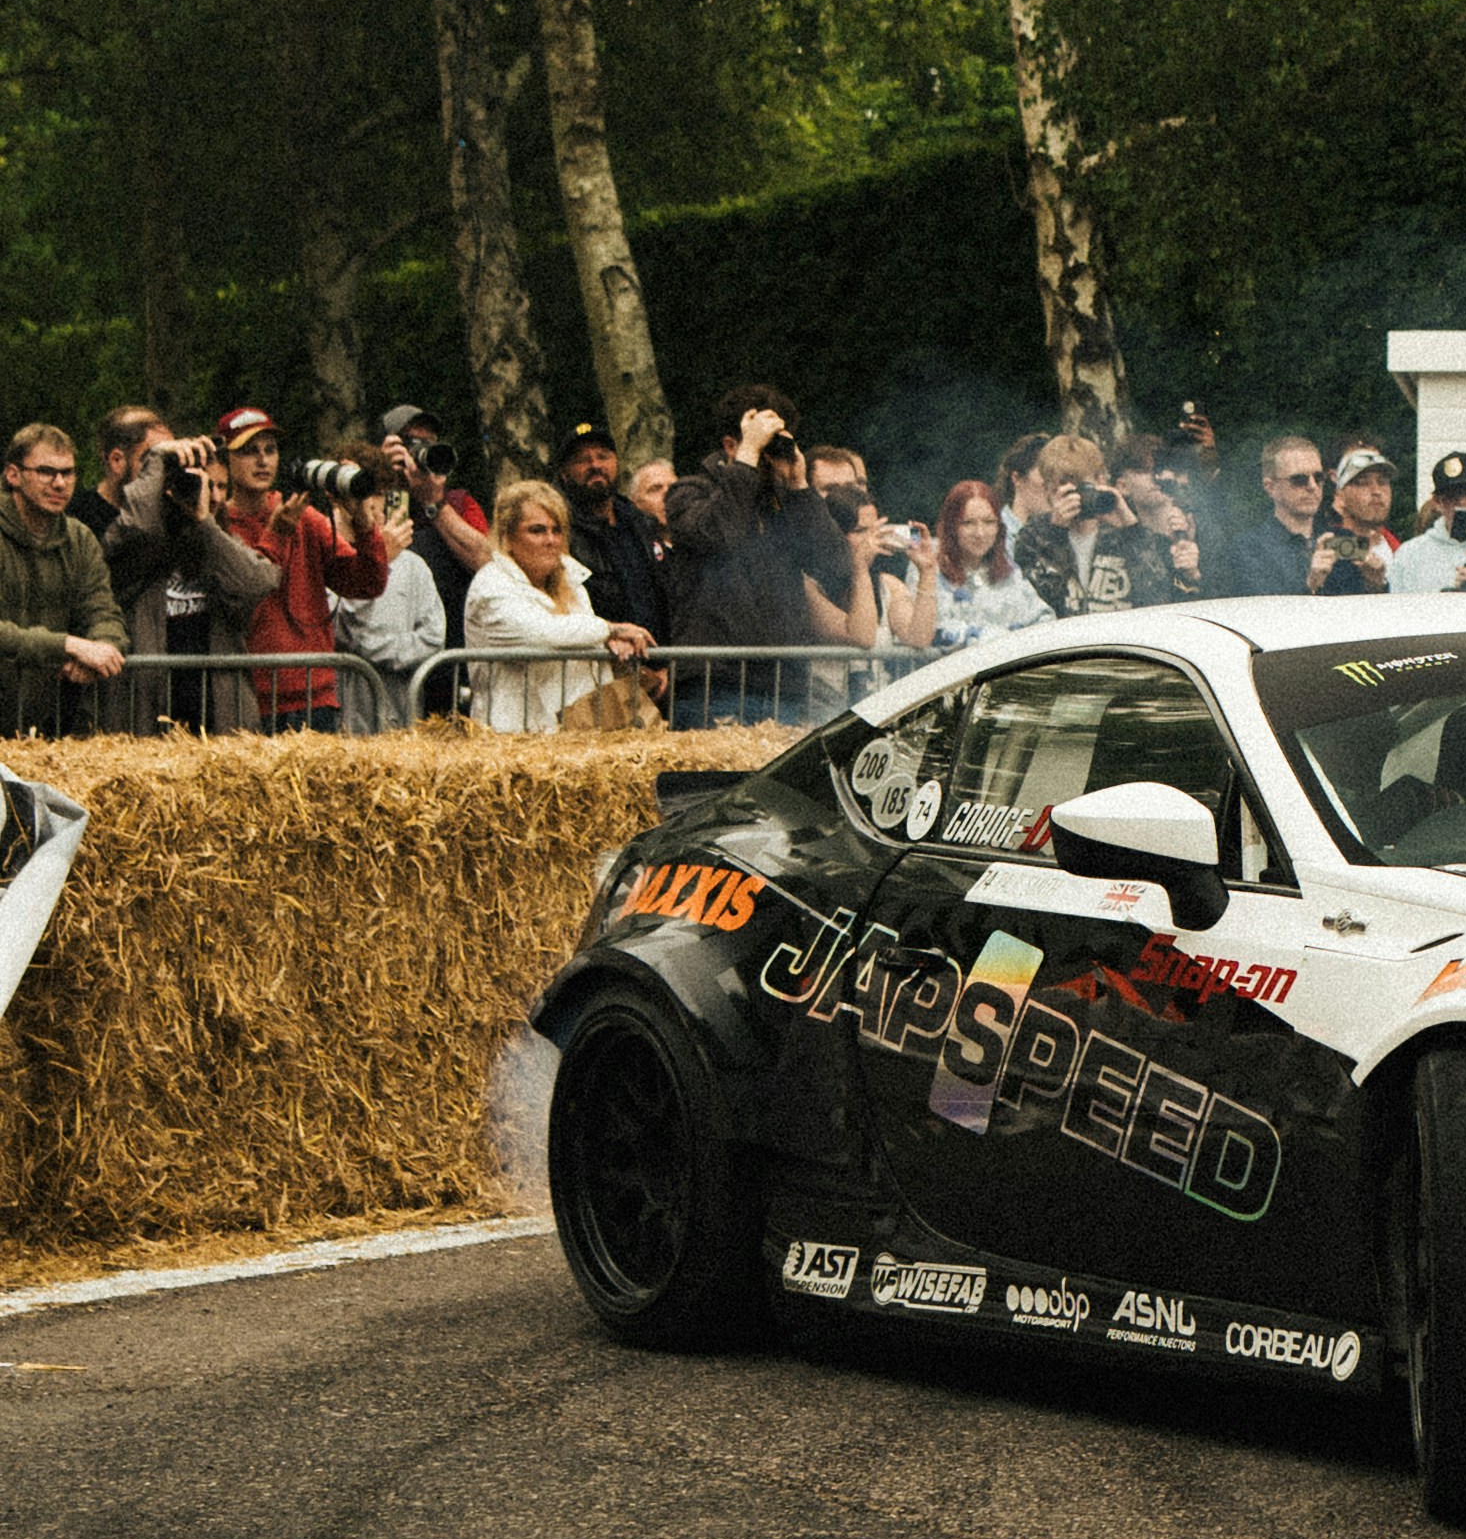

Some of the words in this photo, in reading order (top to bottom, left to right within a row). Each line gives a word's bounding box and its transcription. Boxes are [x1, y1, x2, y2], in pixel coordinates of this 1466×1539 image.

[1376, 652, 1459, 670] MONSTER
[856, 752, 890, 779] 208
[880, 786, 911, 815] 185
[915, 800, 932, 822] 74
[1129, 932, 1299, 1004] Snap-on
[760, 905, 1283, 1221] JAPSPEED
[803, 1246, 857, 1281] AST
[896, 1267, 987, 1306] WISEFAB
[1012, 1313, 1073, 1330] MOTORSPORT
[1049, 1276, 1090, 1334] obp
[1112, 1289, 1197, 1337] ASNU
[1106, 1327, 1158, 1347] PERFORMANCE
[1156, 1335, 1197, 1353] INJECTORS
[1225, 1322, 1336, 1368] CORBEAU
